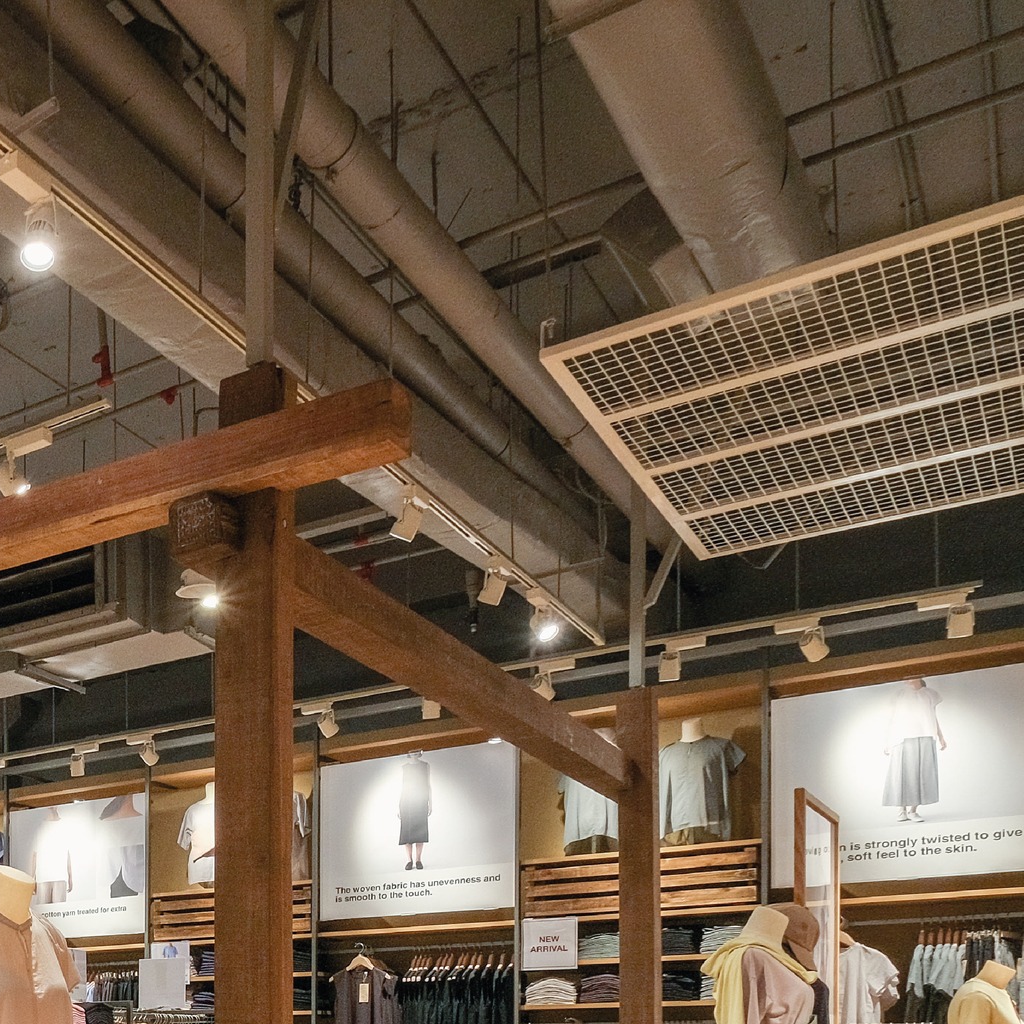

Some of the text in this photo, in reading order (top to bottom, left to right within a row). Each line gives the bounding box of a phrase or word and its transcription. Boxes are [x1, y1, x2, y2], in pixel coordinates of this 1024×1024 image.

[850, 841, 860, 851] is
[864, 838, 918, 850] strongly
[921, 832, 971, 844] twisted
[975, 832, 989, 840] to
[993, 829, 1023, 841] give
[847, 844, 978, 862] soft feel to the skin.
[336, 874, 501, 894] The woven fabric has unevenness and
[345, 893, 376, 902] smooth
[378, 892, 387, 900] to
[390, 891, 403, 899] the
[405, 889, 433, 897] touch.
[62, 910, 76, 918] yarn
[77, 907, 99, 915] treated
